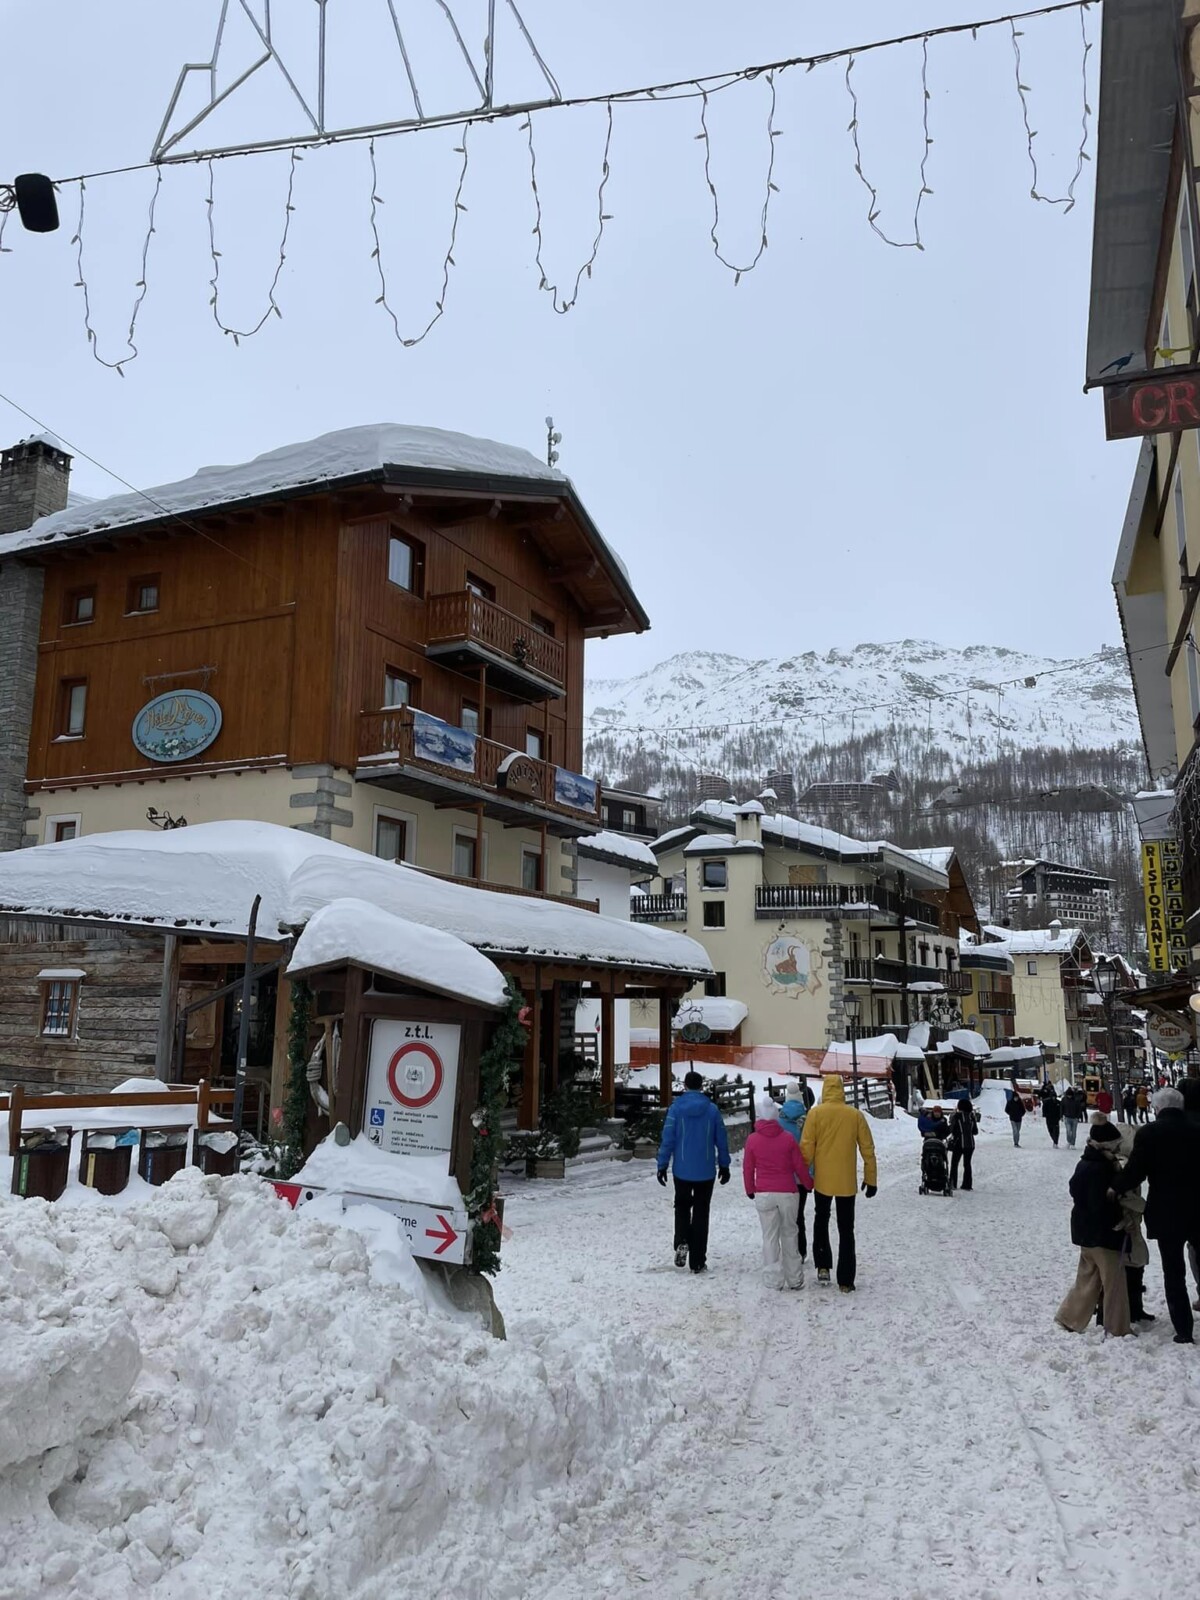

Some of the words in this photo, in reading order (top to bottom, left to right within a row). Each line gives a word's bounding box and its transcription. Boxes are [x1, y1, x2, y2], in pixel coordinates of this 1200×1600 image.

[508, 762, 539, 793] HOTEL
[1145, 845, 1164, 969] RISTORANTE
[933, 1007, 958, 1018] HOTEL
[404, 1025, 433, 1040] z.t.l.
